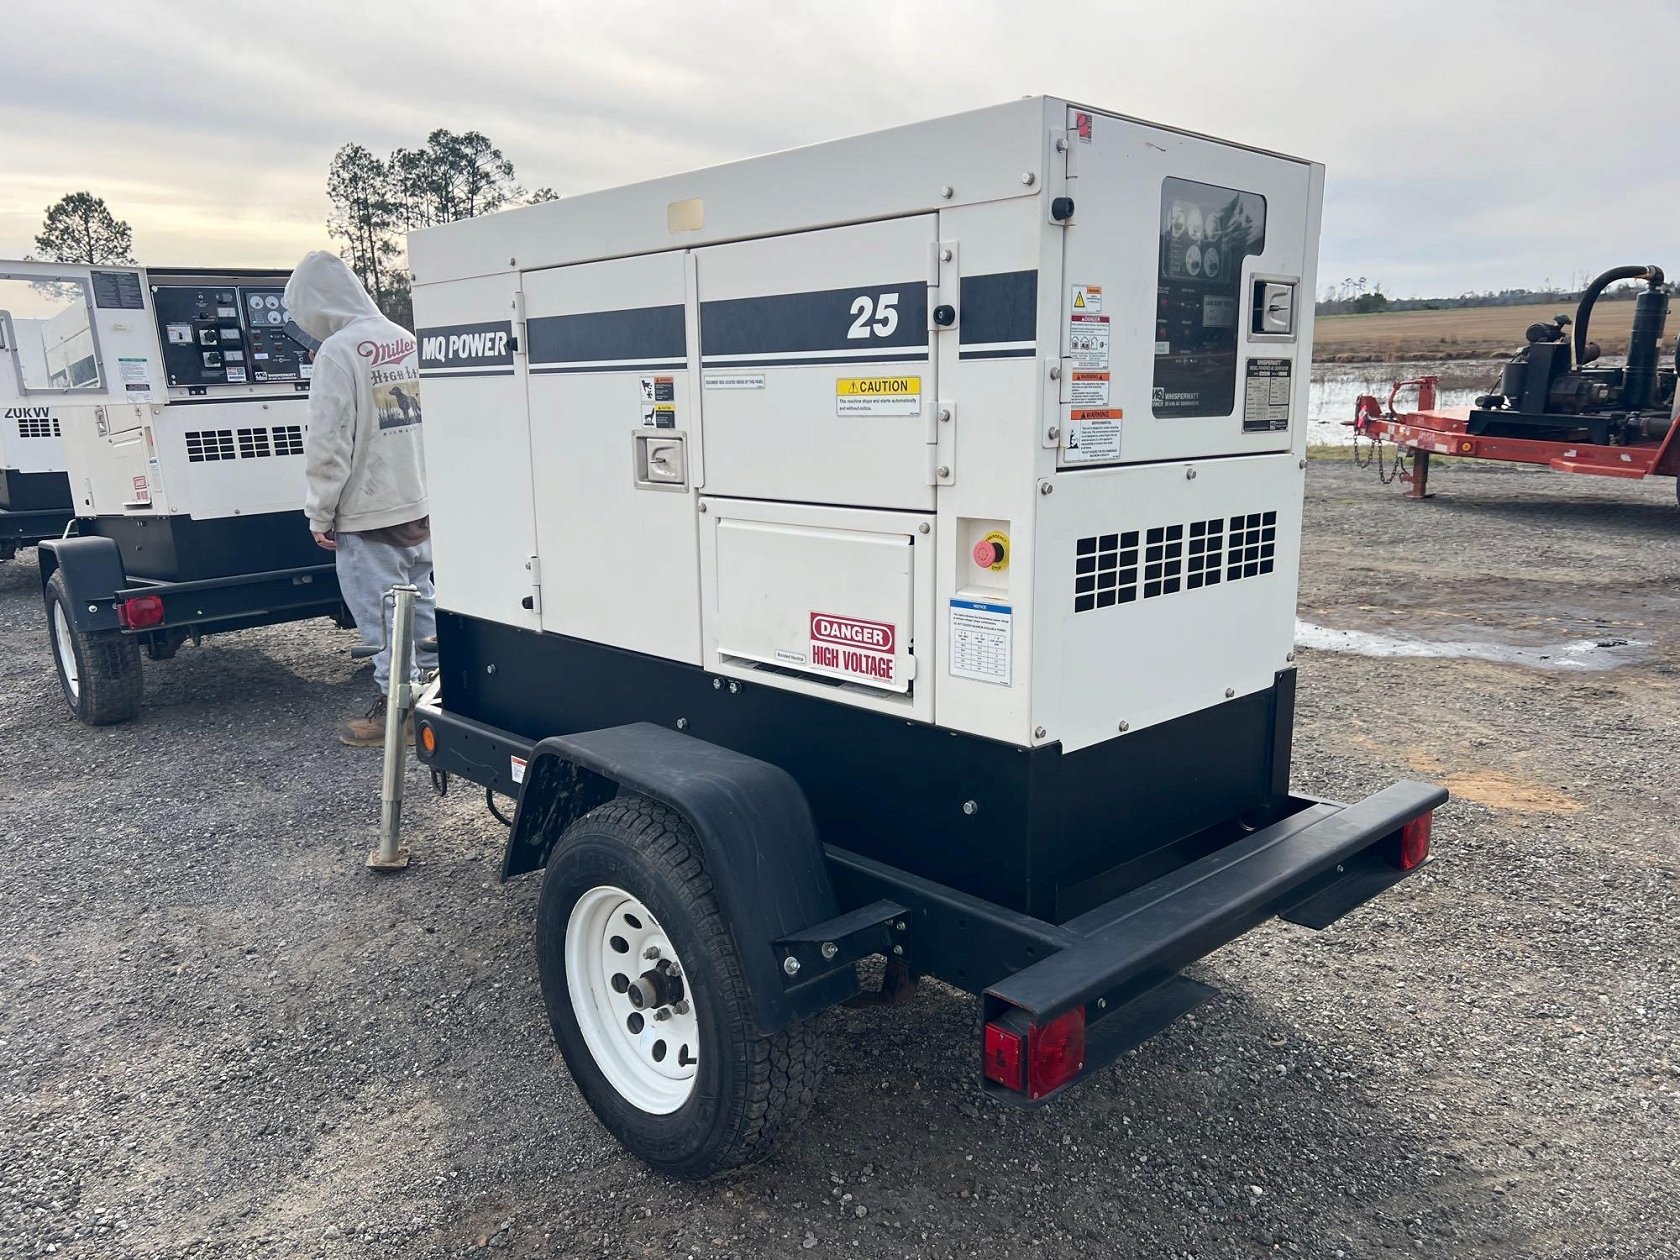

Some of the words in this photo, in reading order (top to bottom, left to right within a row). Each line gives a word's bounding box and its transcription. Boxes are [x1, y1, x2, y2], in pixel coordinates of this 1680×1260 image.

[847, 293, 899, 339] 25
[357, 338, 416, 366] Miller
[422, 337, 446, 363] MQ
[448, 331, 507, 359] POWER
[860, 380, 908, 393] CAUTION
[1086, 411, 1110, 419] WARNING
[820, 621, 884, 645] DANGER
[812, 645, 839, 668] HIGH
[843, 651, 893, 680] VOLTAGE
